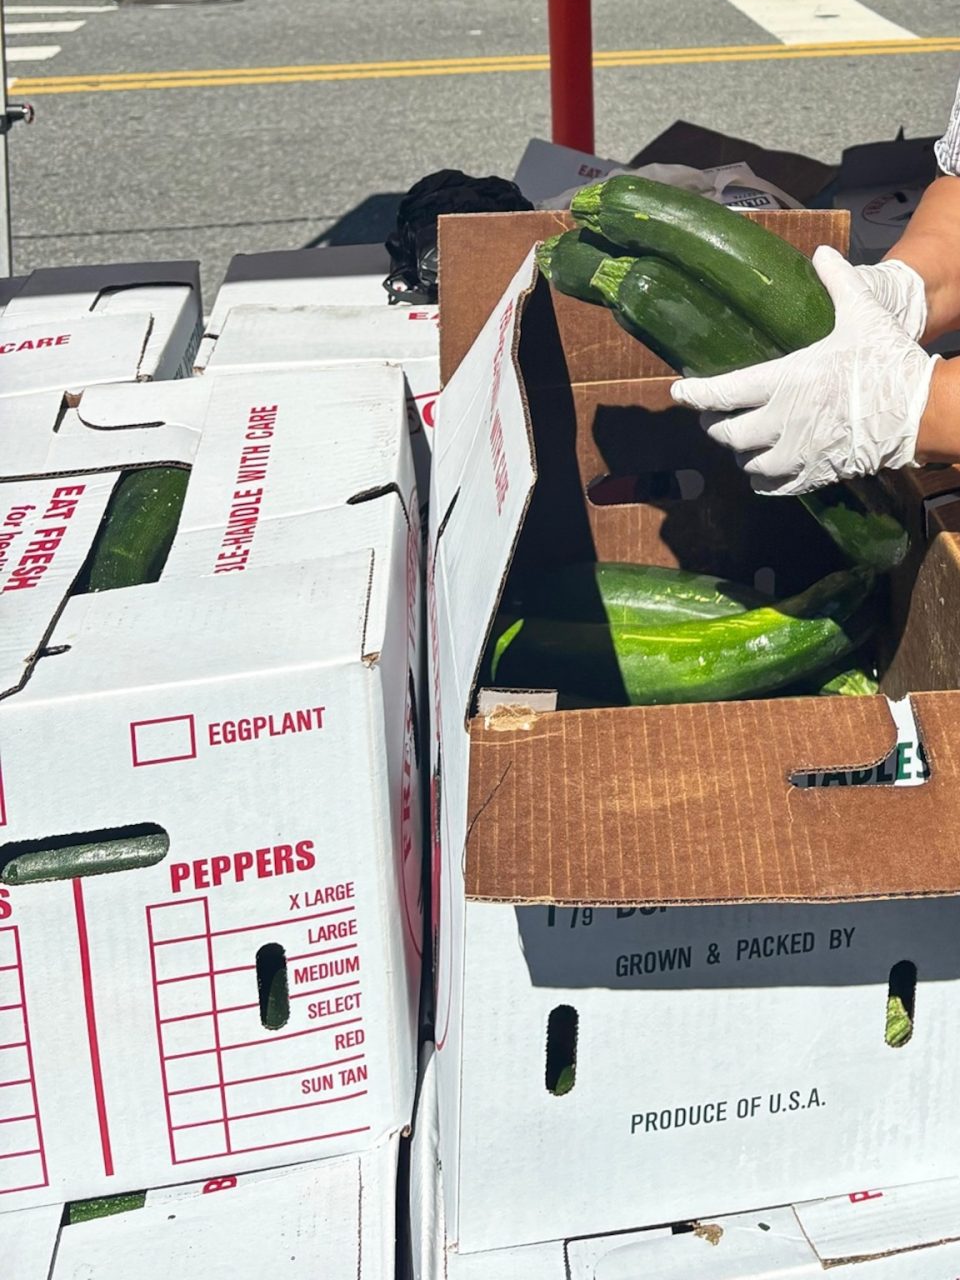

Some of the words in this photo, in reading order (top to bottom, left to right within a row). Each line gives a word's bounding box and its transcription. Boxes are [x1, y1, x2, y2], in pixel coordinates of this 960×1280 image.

[0, 334, 72, 355] CARE
[245, 404, 279, 440] CARE
[236, 444, 272, 485] WITH
[42, 484, 87, 520] EAT
[2, 525, 68, 592] FRESH
[208, 706, 326, 747] EGGPLANT
[169, 839, 316, 894] PEPPERS
[288, 893, 301, 910] X
[304, 881, 356, 907] LARGE
[307, 918, 358, 945] LARGE
[293, 955, 361, 986] MEDIUM
[615, 945, 693, 979] GROWN
[705, 942, 721, 967] &
[735, 930, 816, 963] PACKED
[828, 927, 856, 949] BY
[307, 992, 363, 1021] SELECT
[334, 1028, 366, 1051] RED
[301, 1073, 335, 1096] SUN
[338, 1064, 369, 1089] TAN
[630, 1100, 728, 1135] PRODUCE
[735, 1095, 762, 1120] OF
[769, 1087, 827, 1116] U.S.A.
